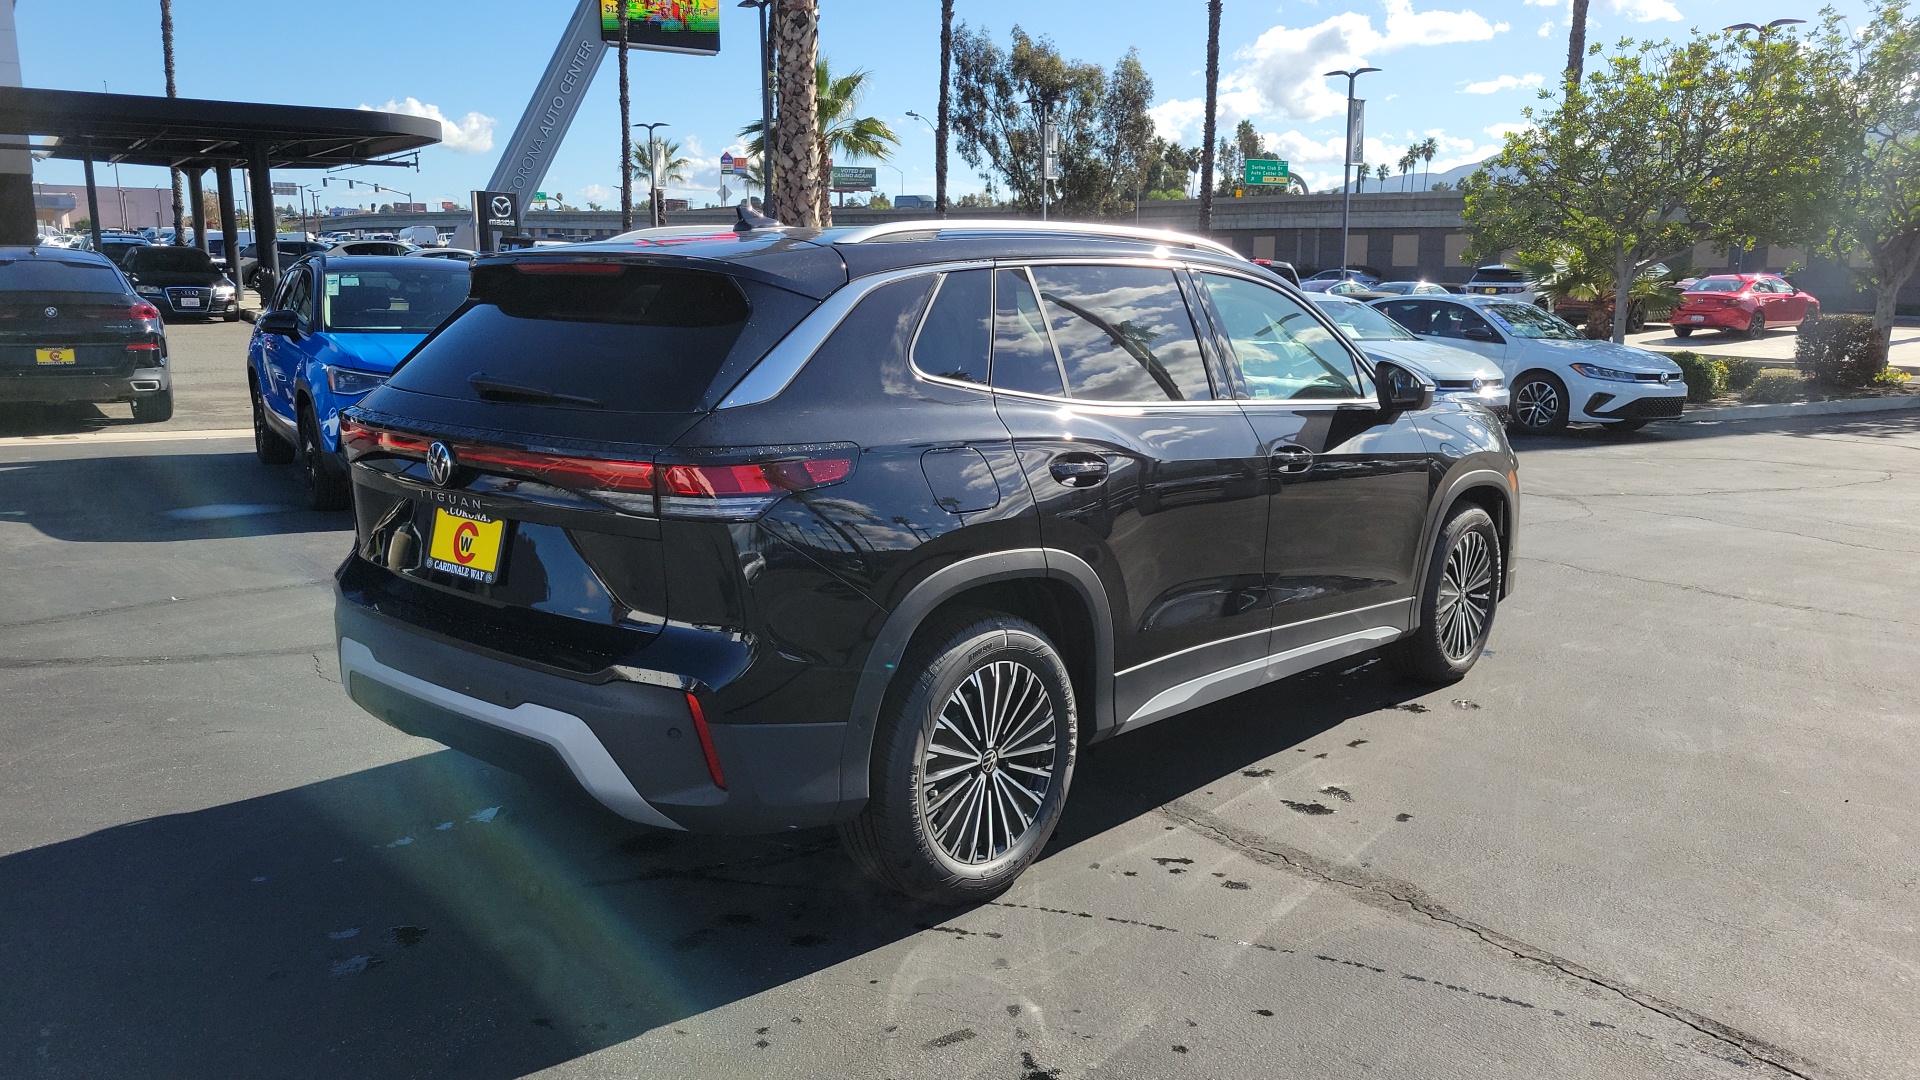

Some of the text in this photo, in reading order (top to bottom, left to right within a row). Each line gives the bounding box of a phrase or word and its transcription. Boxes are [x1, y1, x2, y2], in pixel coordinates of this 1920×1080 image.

[539, 96, 565, 138] AUTO
[559, 39, 594, 94] CENTER
[489, 219, 515, 227] mazda
[420, 489, 481, 509] TIGUAN
[434, 560, 485, 581] CARDINALE WAY
